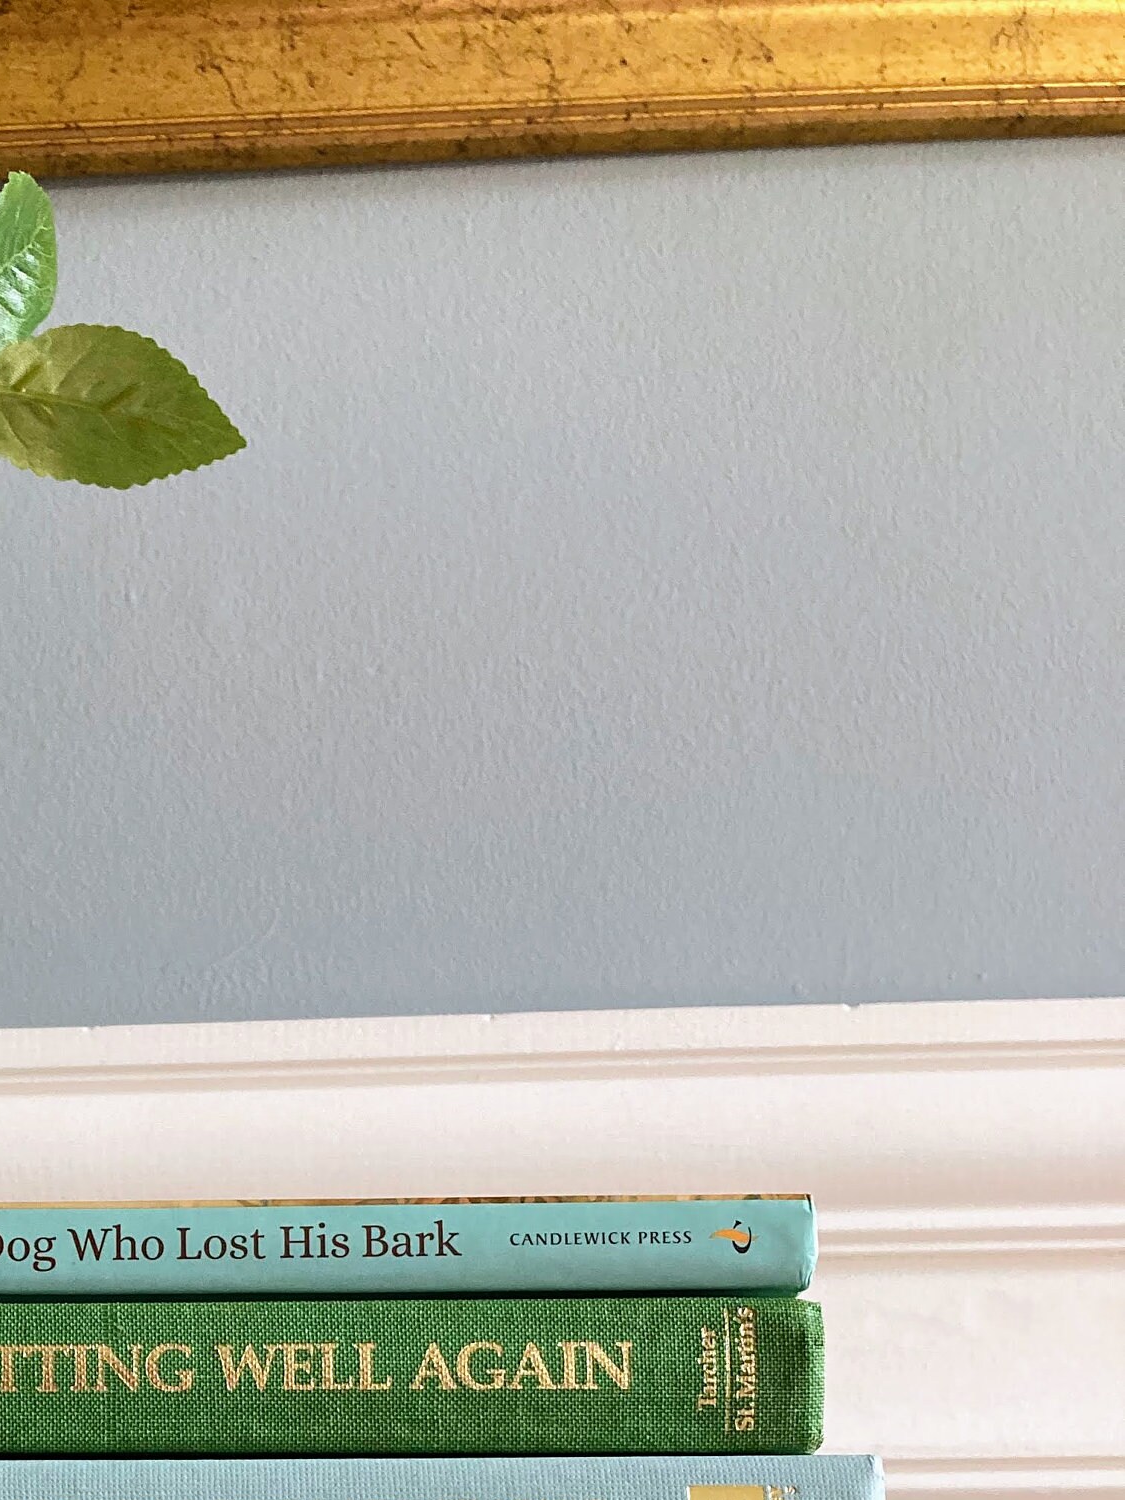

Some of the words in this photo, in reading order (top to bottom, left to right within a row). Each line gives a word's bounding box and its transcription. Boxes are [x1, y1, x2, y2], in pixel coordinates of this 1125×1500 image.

[67, 1226, 164, 1263] Who
[176, 1225, 266, 1262] Lost
[280, 1224, 350, 1261] His
[362, 1221, 462, 1259] Bark
[509, 1231, 631, 1247] CANDLEWICK
[639, 1230, 692, 1246] PRESS
[216, 1341, 392, 1392] WELL
[412, 1340, 633, 1391] AGAIN
